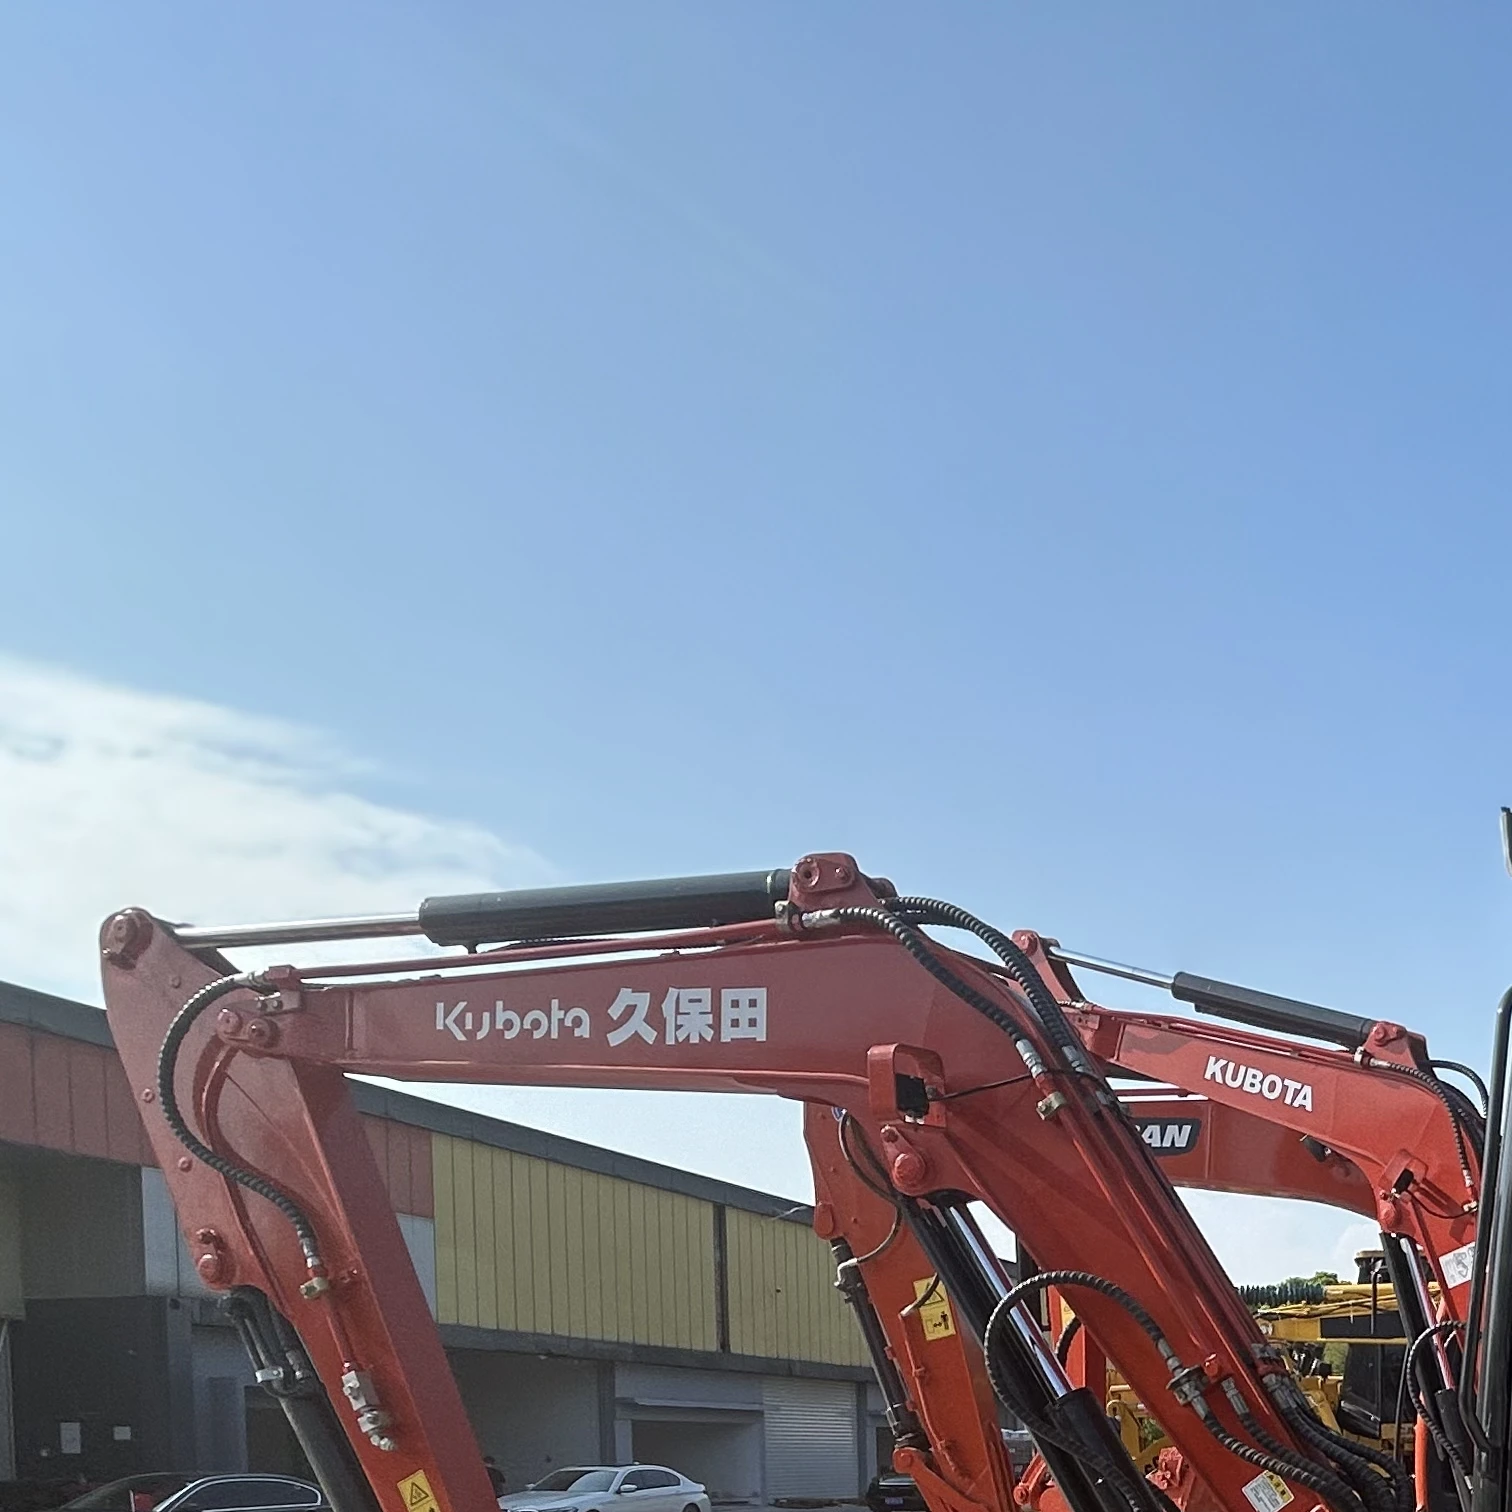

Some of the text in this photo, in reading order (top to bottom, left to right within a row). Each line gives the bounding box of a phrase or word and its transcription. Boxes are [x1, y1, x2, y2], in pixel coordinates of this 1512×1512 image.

[436, 987, 767, 1047] Kubota 久保田
[1204, 1055, 1313, 1112] KUBOTA
[1135, 1124, 1192, 1147] AN
